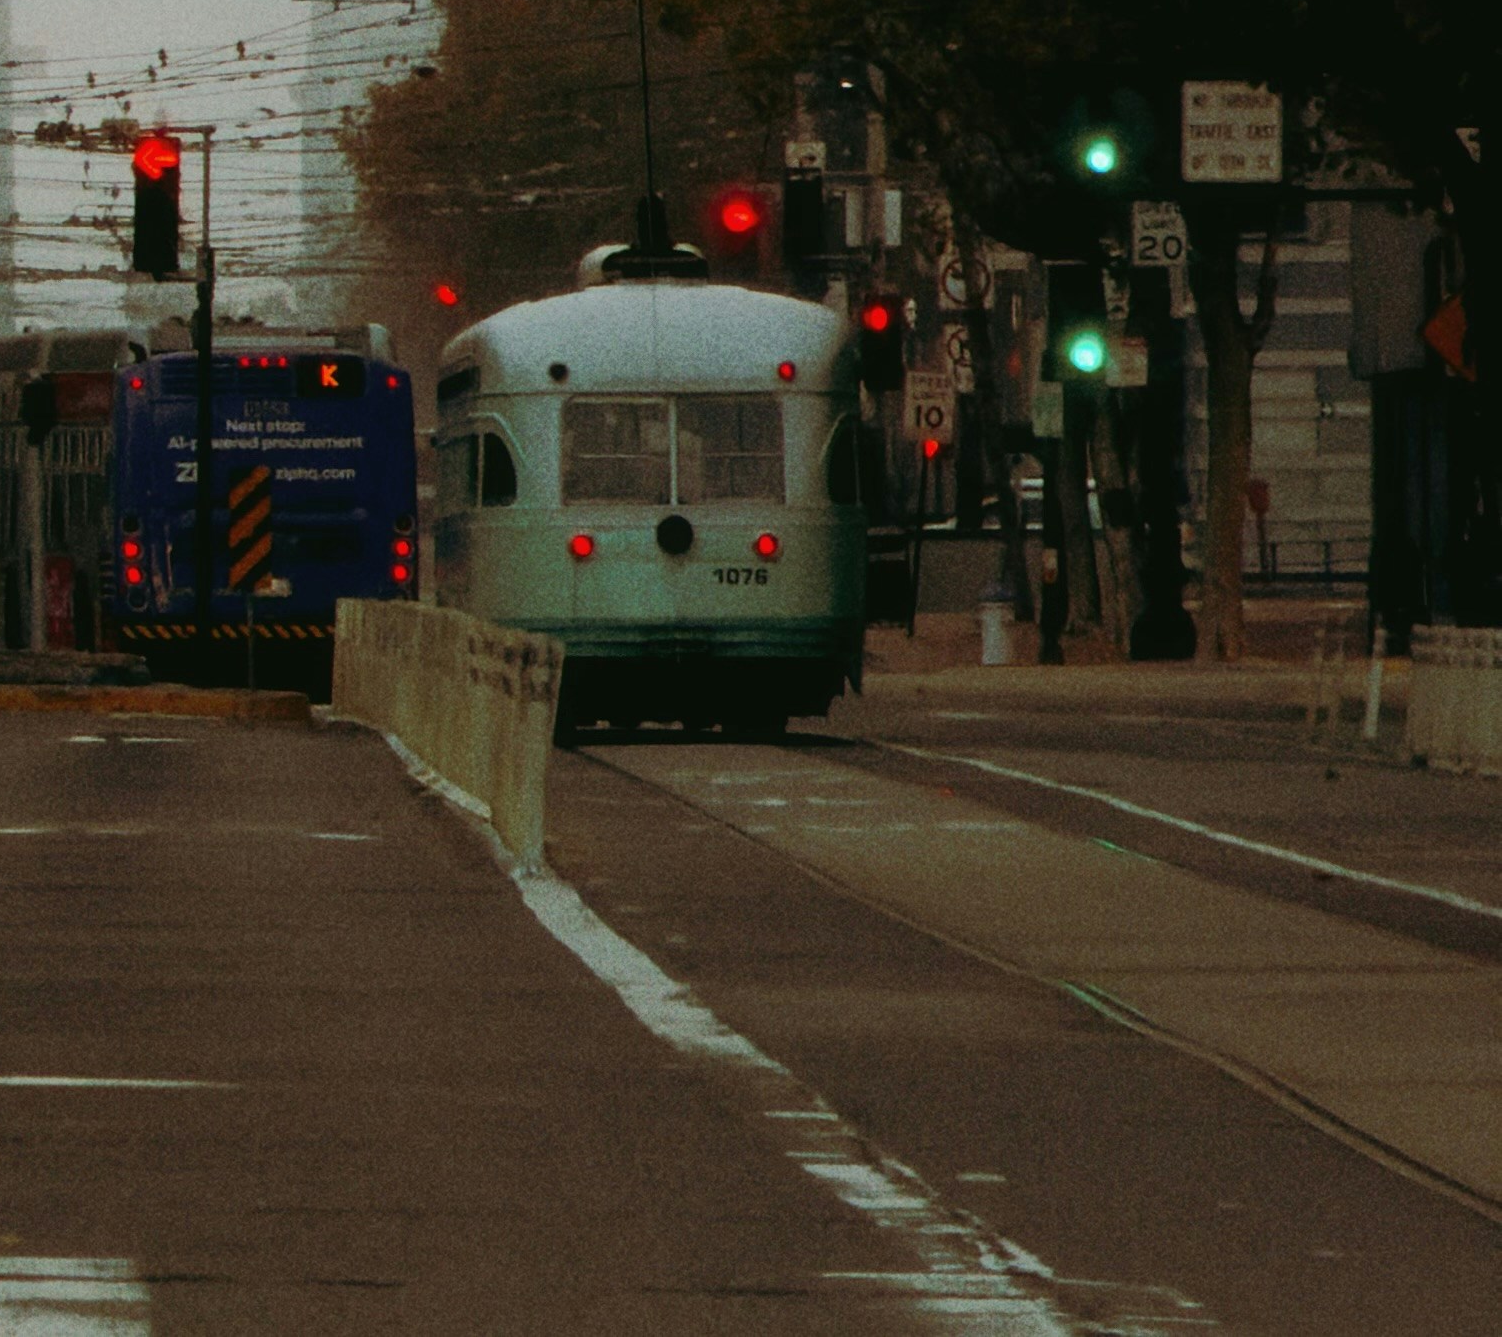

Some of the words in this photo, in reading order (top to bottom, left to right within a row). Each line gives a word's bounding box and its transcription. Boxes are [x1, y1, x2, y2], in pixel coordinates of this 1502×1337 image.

[1138, 235, 1182, 261] 20
[318, 362, 340, 388] K
[914, 405, 944, 428] 10
[225, 419, 263, 432] Next
[265, 419, 306, 433] stop:
[166, 435, 259, 451] AI-pwered
[261, 435, 364, 451] procurement
[275, 466, 356, 481] ziphq.com
[712, 567, 769, 585] 1076
